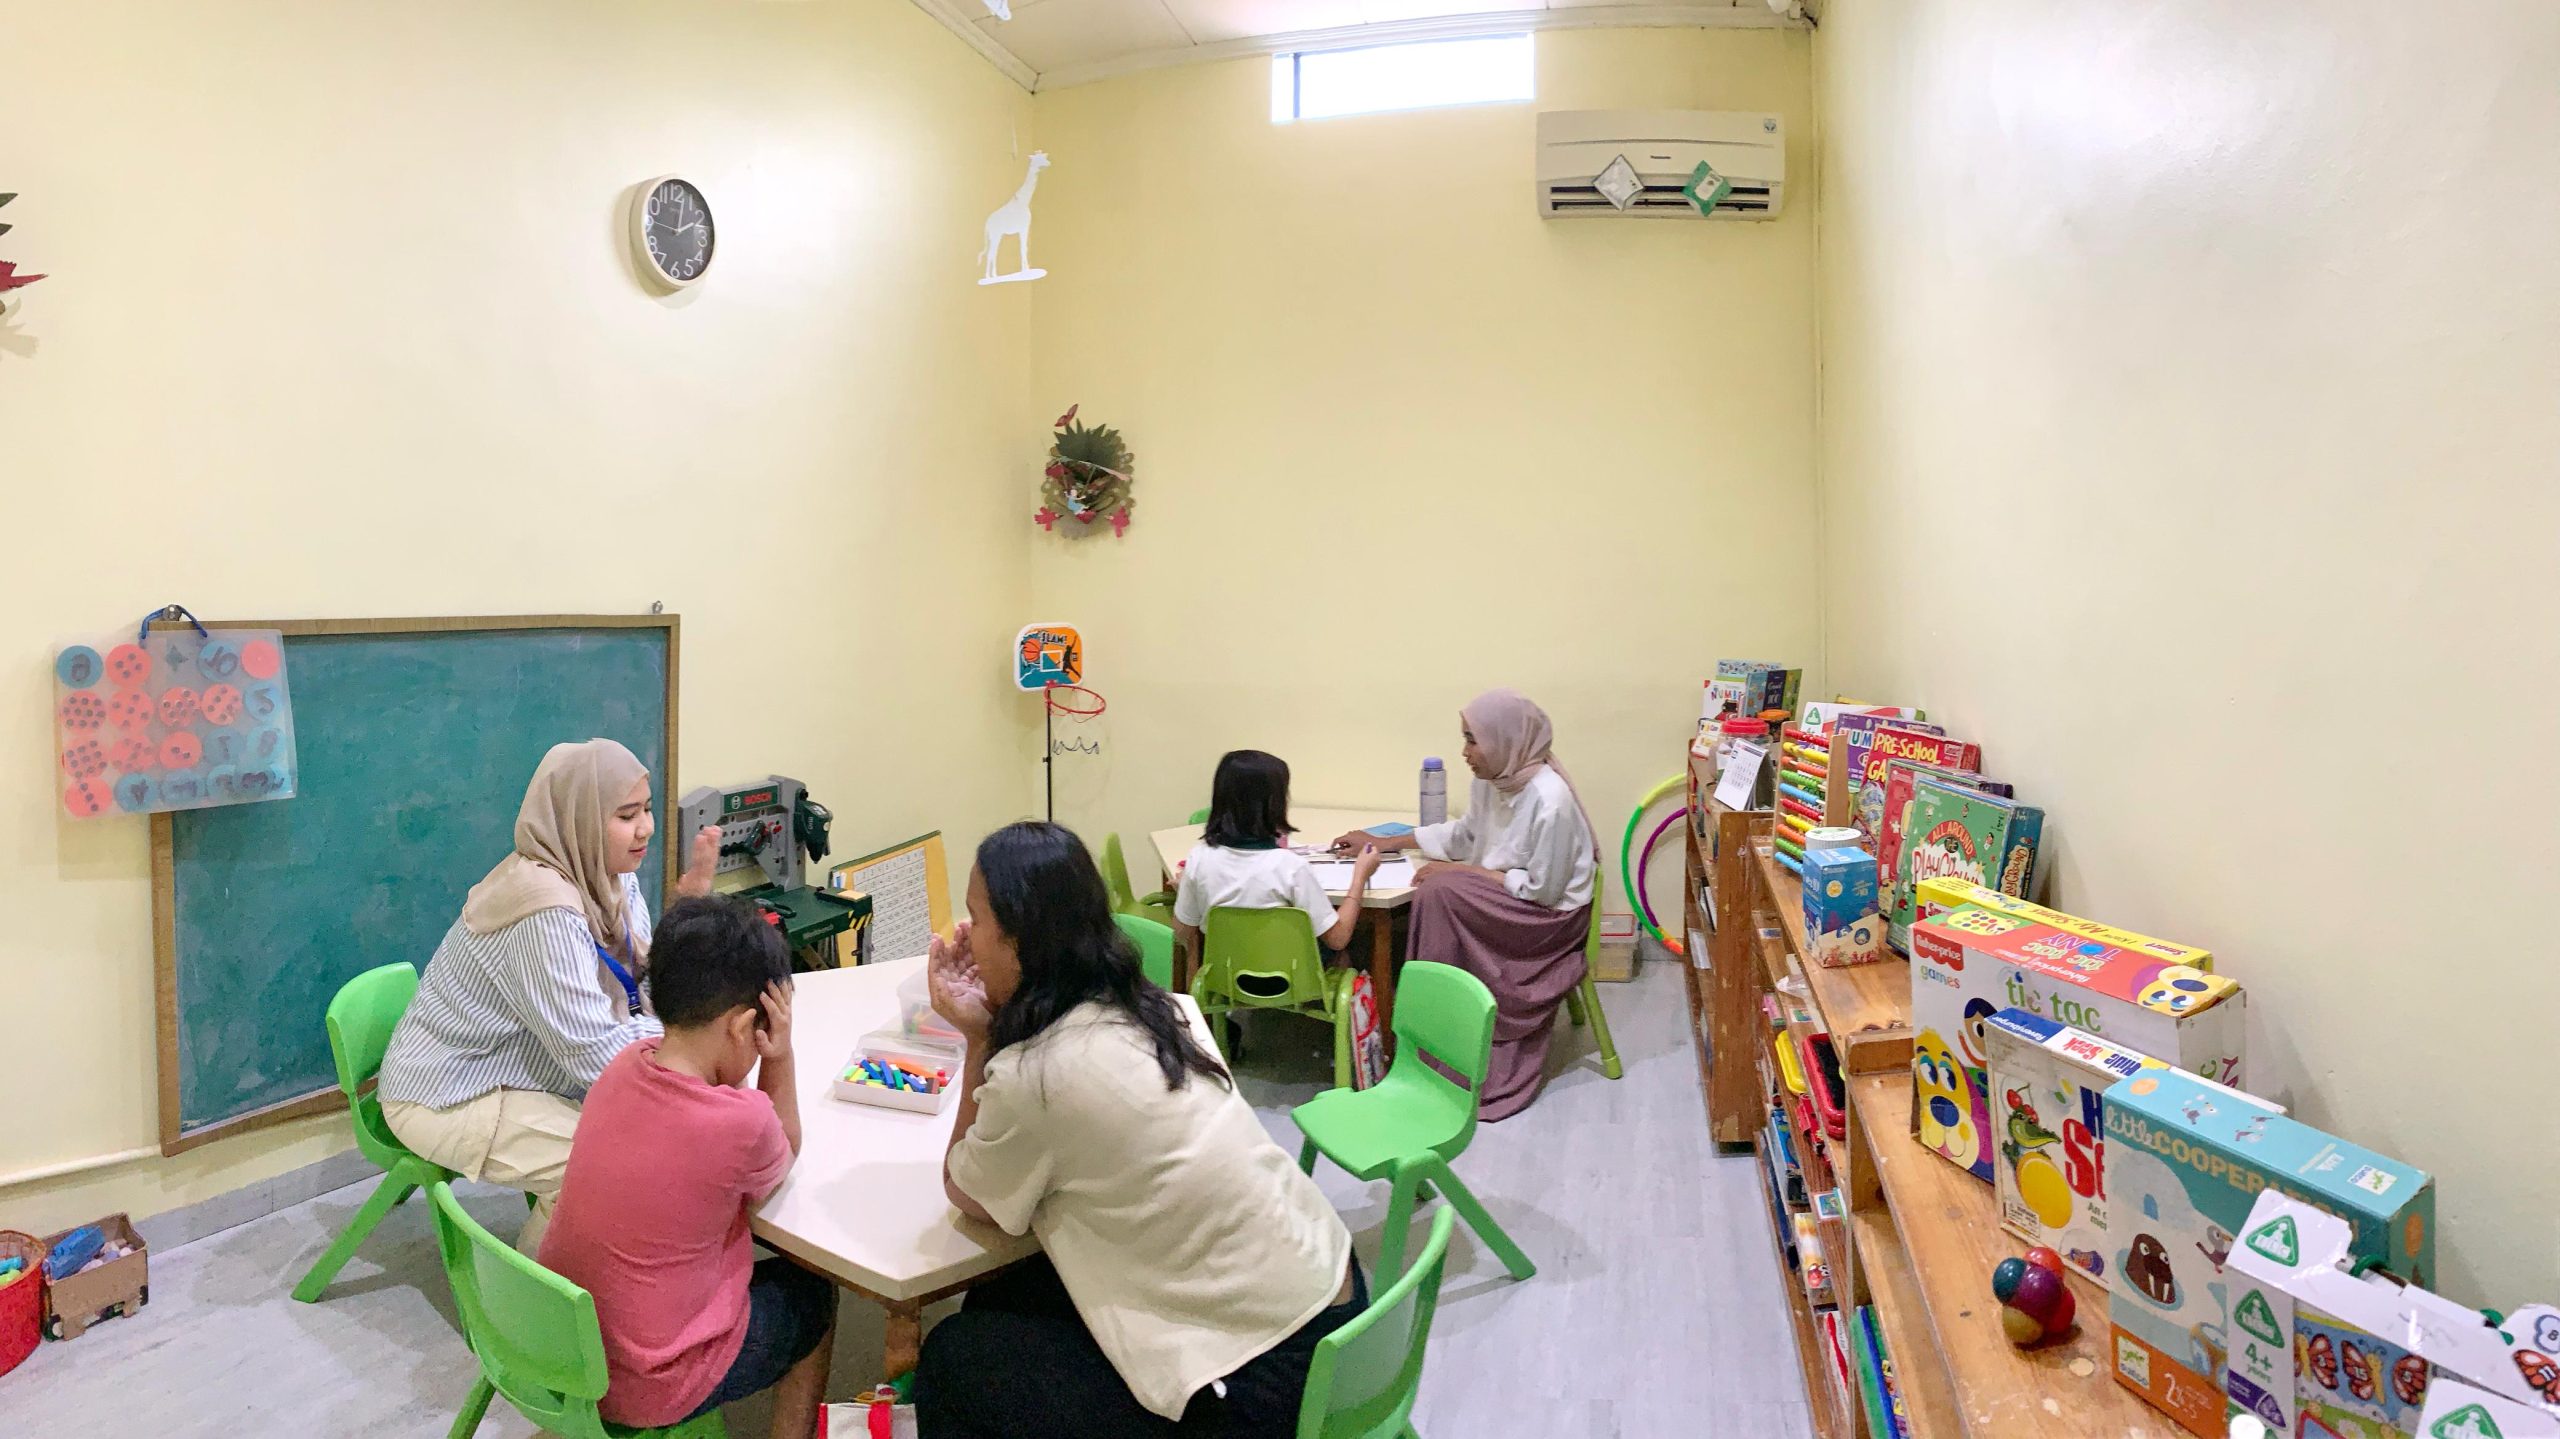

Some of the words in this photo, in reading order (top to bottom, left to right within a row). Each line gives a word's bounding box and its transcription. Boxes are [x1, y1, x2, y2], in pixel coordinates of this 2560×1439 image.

[671, 183, 684, 203] 12
[695, 209, 708, 228] 2
[648, 235, 658, 254] 8
[697, 229, 708, 248] 3
[683, 258, 694, 277] 5
[694, 250, 704, 266] 4
[670, 261, 680, 279] 6
[1920, 965, 1961, 989] games
[2052, 991, 2102, 1033] tac
[2063, 1037, 2104, 1061] Seek
[2103, 1053, 2142, 1077] Hide
[2538, 1365, 2557, 1382] 11
